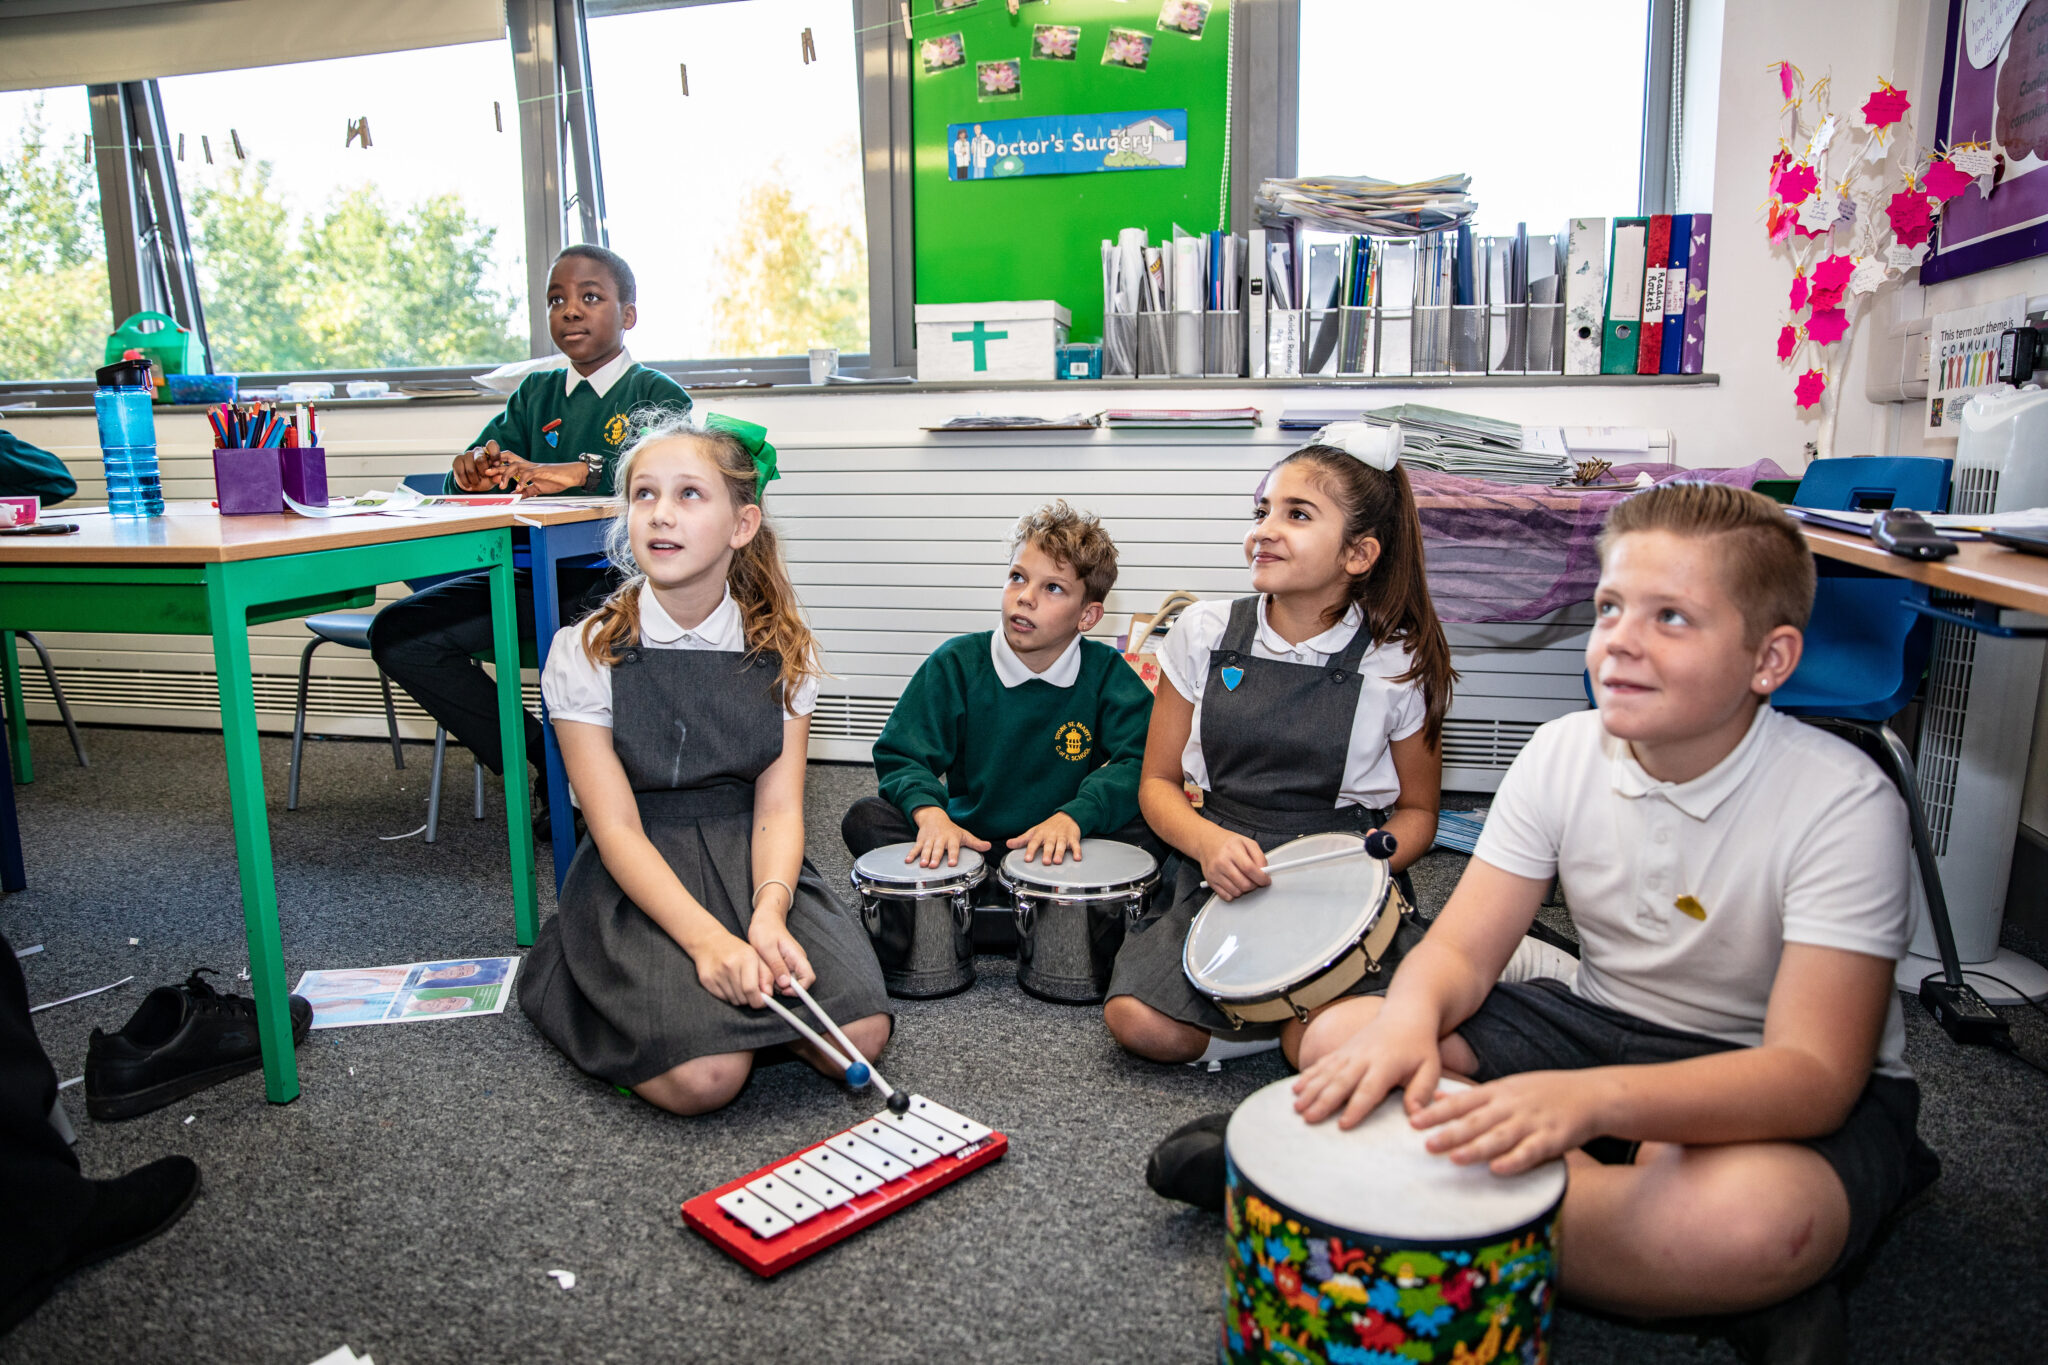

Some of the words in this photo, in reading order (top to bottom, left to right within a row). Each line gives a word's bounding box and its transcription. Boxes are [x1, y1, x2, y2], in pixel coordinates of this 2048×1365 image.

[981, 134, 1064, 158] Doctor's
[1072, 133, 1153, 157] Surgery
[1646, 276, 1657, 312] Rockets
[1652, 272, 1666, 311] Reading
[1288, 314, 1296, 341] Guided
[1941, 329, 1954, 341] This
[1956, 327, 1972, 339] term
[1973, 325, 1985, 336] our
[1986, 321, 2008, 334] theme
[2008, 317, 2014, 329] is
[1285, 344, 1295, 374] Reading
[1941, 337, 1995, 357] COMMUNI
